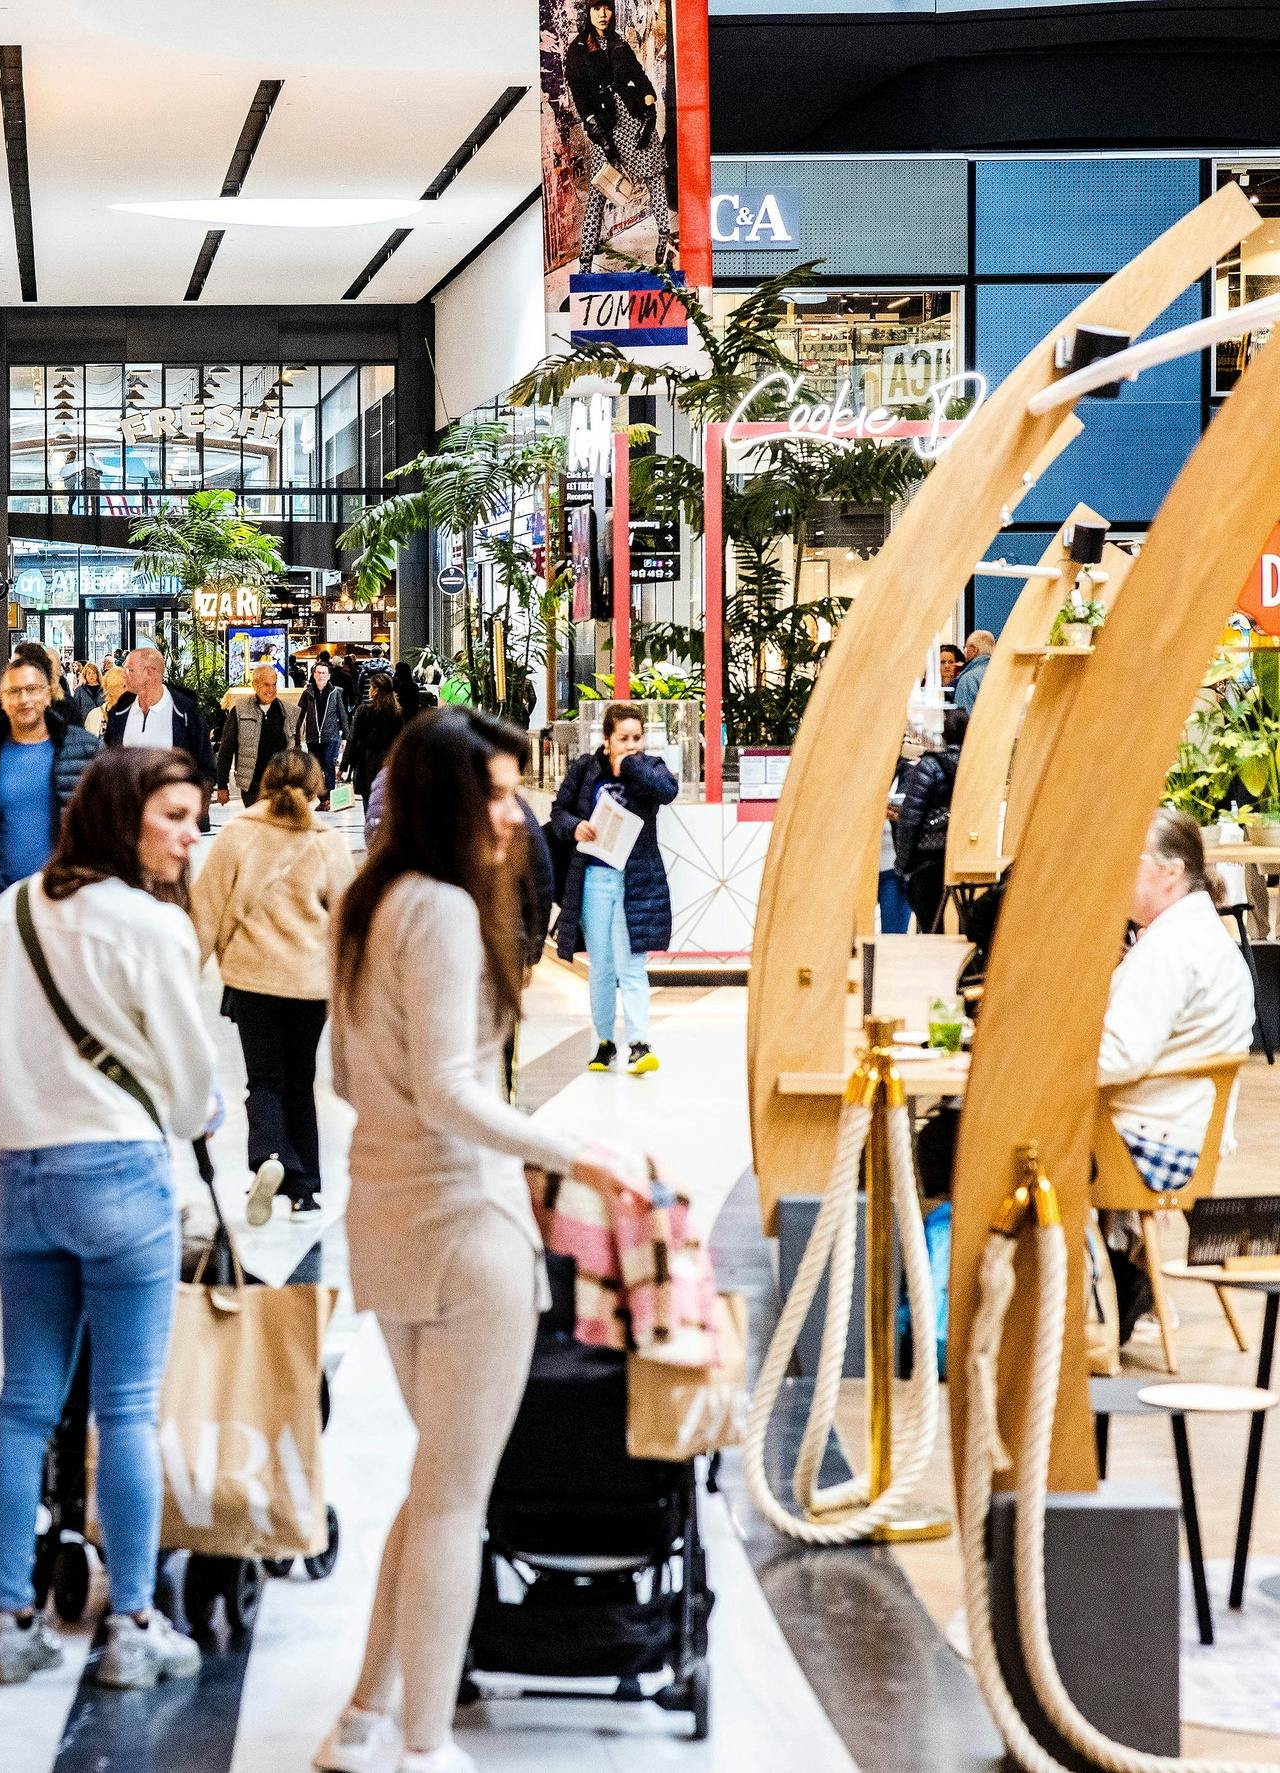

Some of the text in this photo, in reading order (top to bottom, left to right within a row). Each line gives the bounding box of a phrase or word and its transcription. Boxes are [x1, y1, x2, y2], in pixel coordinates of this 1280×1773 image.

[710, 194, 792, 242] C&A
[578, 292, 675, 327] TOMMY
[120, 403, 286, 445] FRESH!
[724, 371, 899, 450] Cookie
